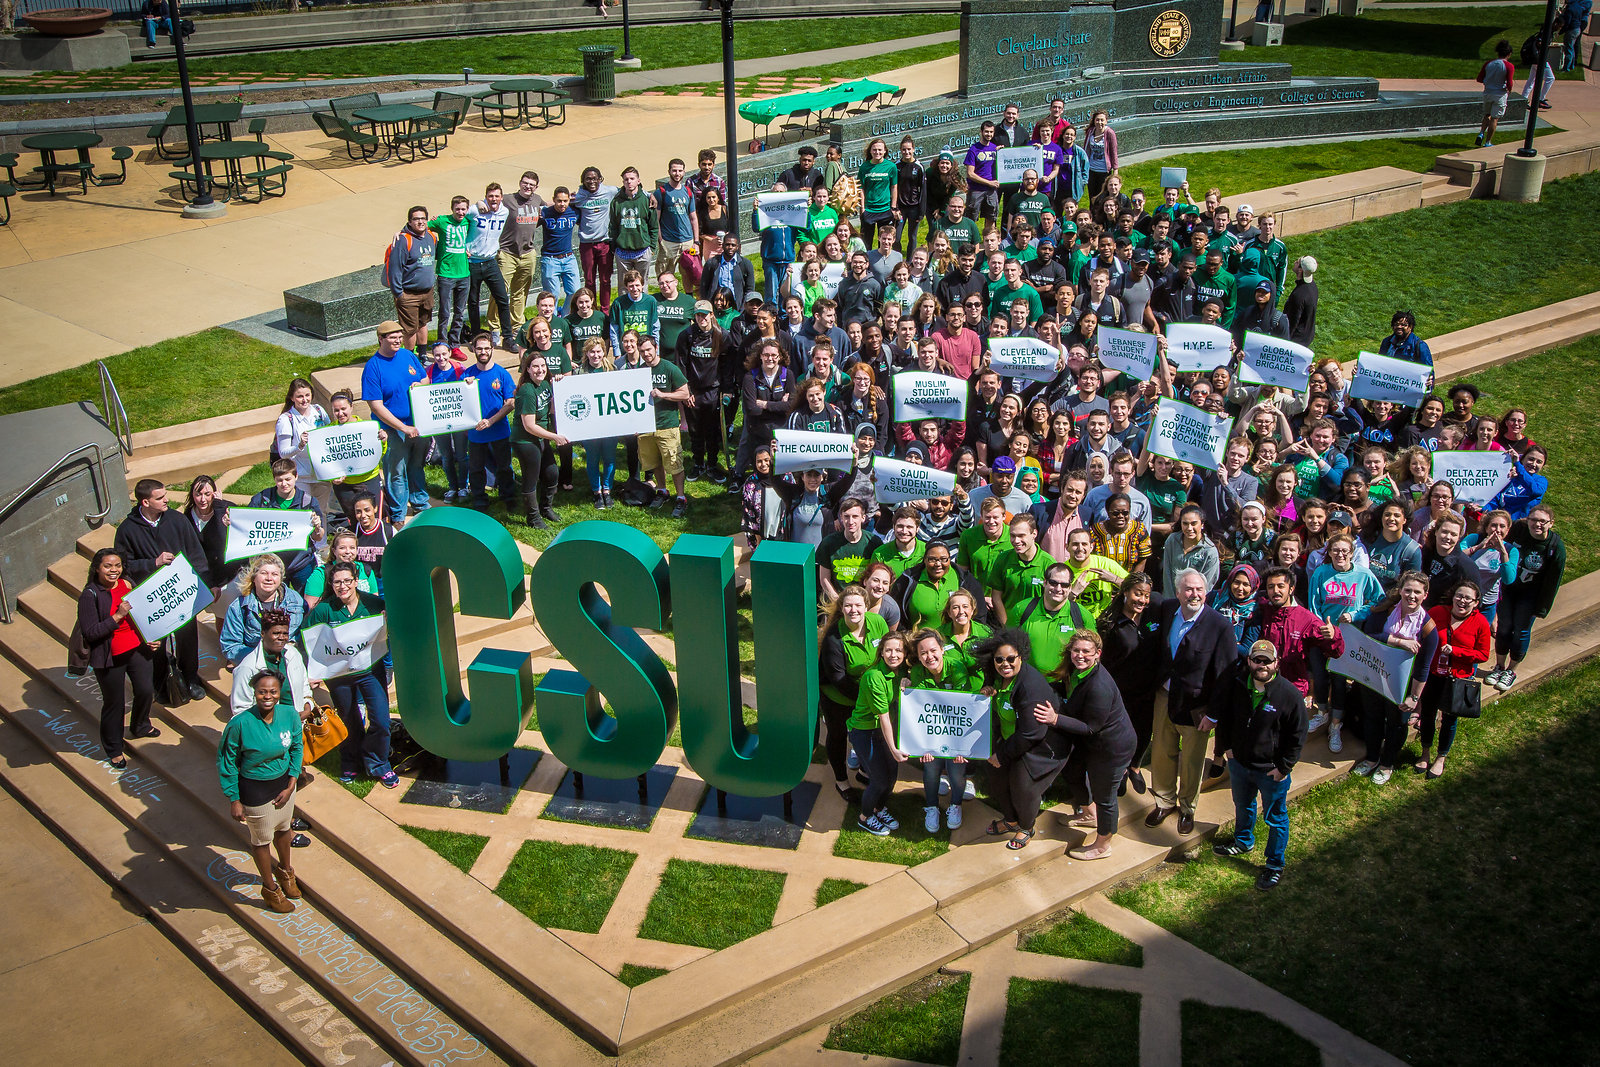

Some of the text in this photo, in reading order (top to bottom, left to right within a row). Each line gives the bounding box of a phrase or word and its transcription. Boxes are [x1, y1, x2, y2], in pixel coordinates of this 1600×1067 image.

[997, 30, 1092, 57] Cleveland State
[1023, 50, 1083, 71] University
[1150, 71, 1268, 90] College of Urban Affairs
[1045, 85, 1102, 104] College of Law
[1280, 88, 1365, 103] College of Science
[1153, 94, 1265, 112] College of Engineering
[872, 120, 903, 137] College
[907, 116, 920, 128] of
[923, 112, 959, 127] Business
[948, 132, 980, 150] College
[1003, 162, 1036, 170] FRATERNITY
[764, 204, 801, 212] WCSB 89.3
[1028, 201, 1043, 209] TASC
[953, 229, 969, 237] TASC
[665, 306, 684, 315] TASC
[583, 325, 601, 336] TASC
[1108, 337, 1146, 349] LEBANESE
[1183, 340, 1215, 351] H.Y.P.E.
[1000, 347, 1048, 356] CLEVELAND
[1111, 344, 1144, 356] STUDENT
[1262, 344, 1295, 358] GLOBAL
[1011, 356, 1036, 365] STATE
[1102, 350, 1151, 366] ORGANIZATION
[1259, 352, 1295, 366] MEDICAL
[1255, 359, 1296, 374] BRIGADES
[915, 380, 947, 388] MUSLIM
[1359, 366, 1424, 390] DELTA OMEGA PHI
[429, 387, 461, 397] NEWMAN
[912, 388, 950, 397] STUDENT
[1370, 379, 1408, 393] SORORITY
[428, 394, 463, 405] CATHOLIC
[593, 389, 646, 417] TASC
[904, 396, 959, 405] ASSOCIATION
[432, 402, 461, 413] CAMPUS
[432, 410, 464, 421] MINISTRY
[1173, 413, 1213, 434] STUDENT
[1161, 419, 1220, 444] GOVERNMENT
[325, 433, 364, 446] STUDENT
[1159, 429, 1217, 453] ASSOCIATION
[328, 442, 363, 454] NURSES
[779, 443, 849, 453] THE CAULDRON
[320, 448, 375, 464] ASSOCIATION
[900, 468, 929, 480] SAUDI
[1446, 469, 1499, 478] DELTA ZETA
[889, 477, 938, 490] STUDENTS
[1449, 478, 1496, 487] SORORITY
[883, 484, 945, 497] ASSOCIATION
[254, 520, 289, 530] QUEER
[248, 529, 294, 539] STUDENT
[146, 572, 181, 603] STUDENT
[160, 587, 179, 605] BAR
[1076, 589, 1104, 606] SU
[147, 583, 199, 625] ASSOCIATION
[381, 505, 821, 799] CSU
[1358, 646, 1386, 669] PHI MU
[1349, 650, 1391, 679] SORORITY
[923, 703, 967, 716] CAMPUS
[917, 713, 973, 727] ACTIVITIES
[926, 725, 964, 737] BOARD
